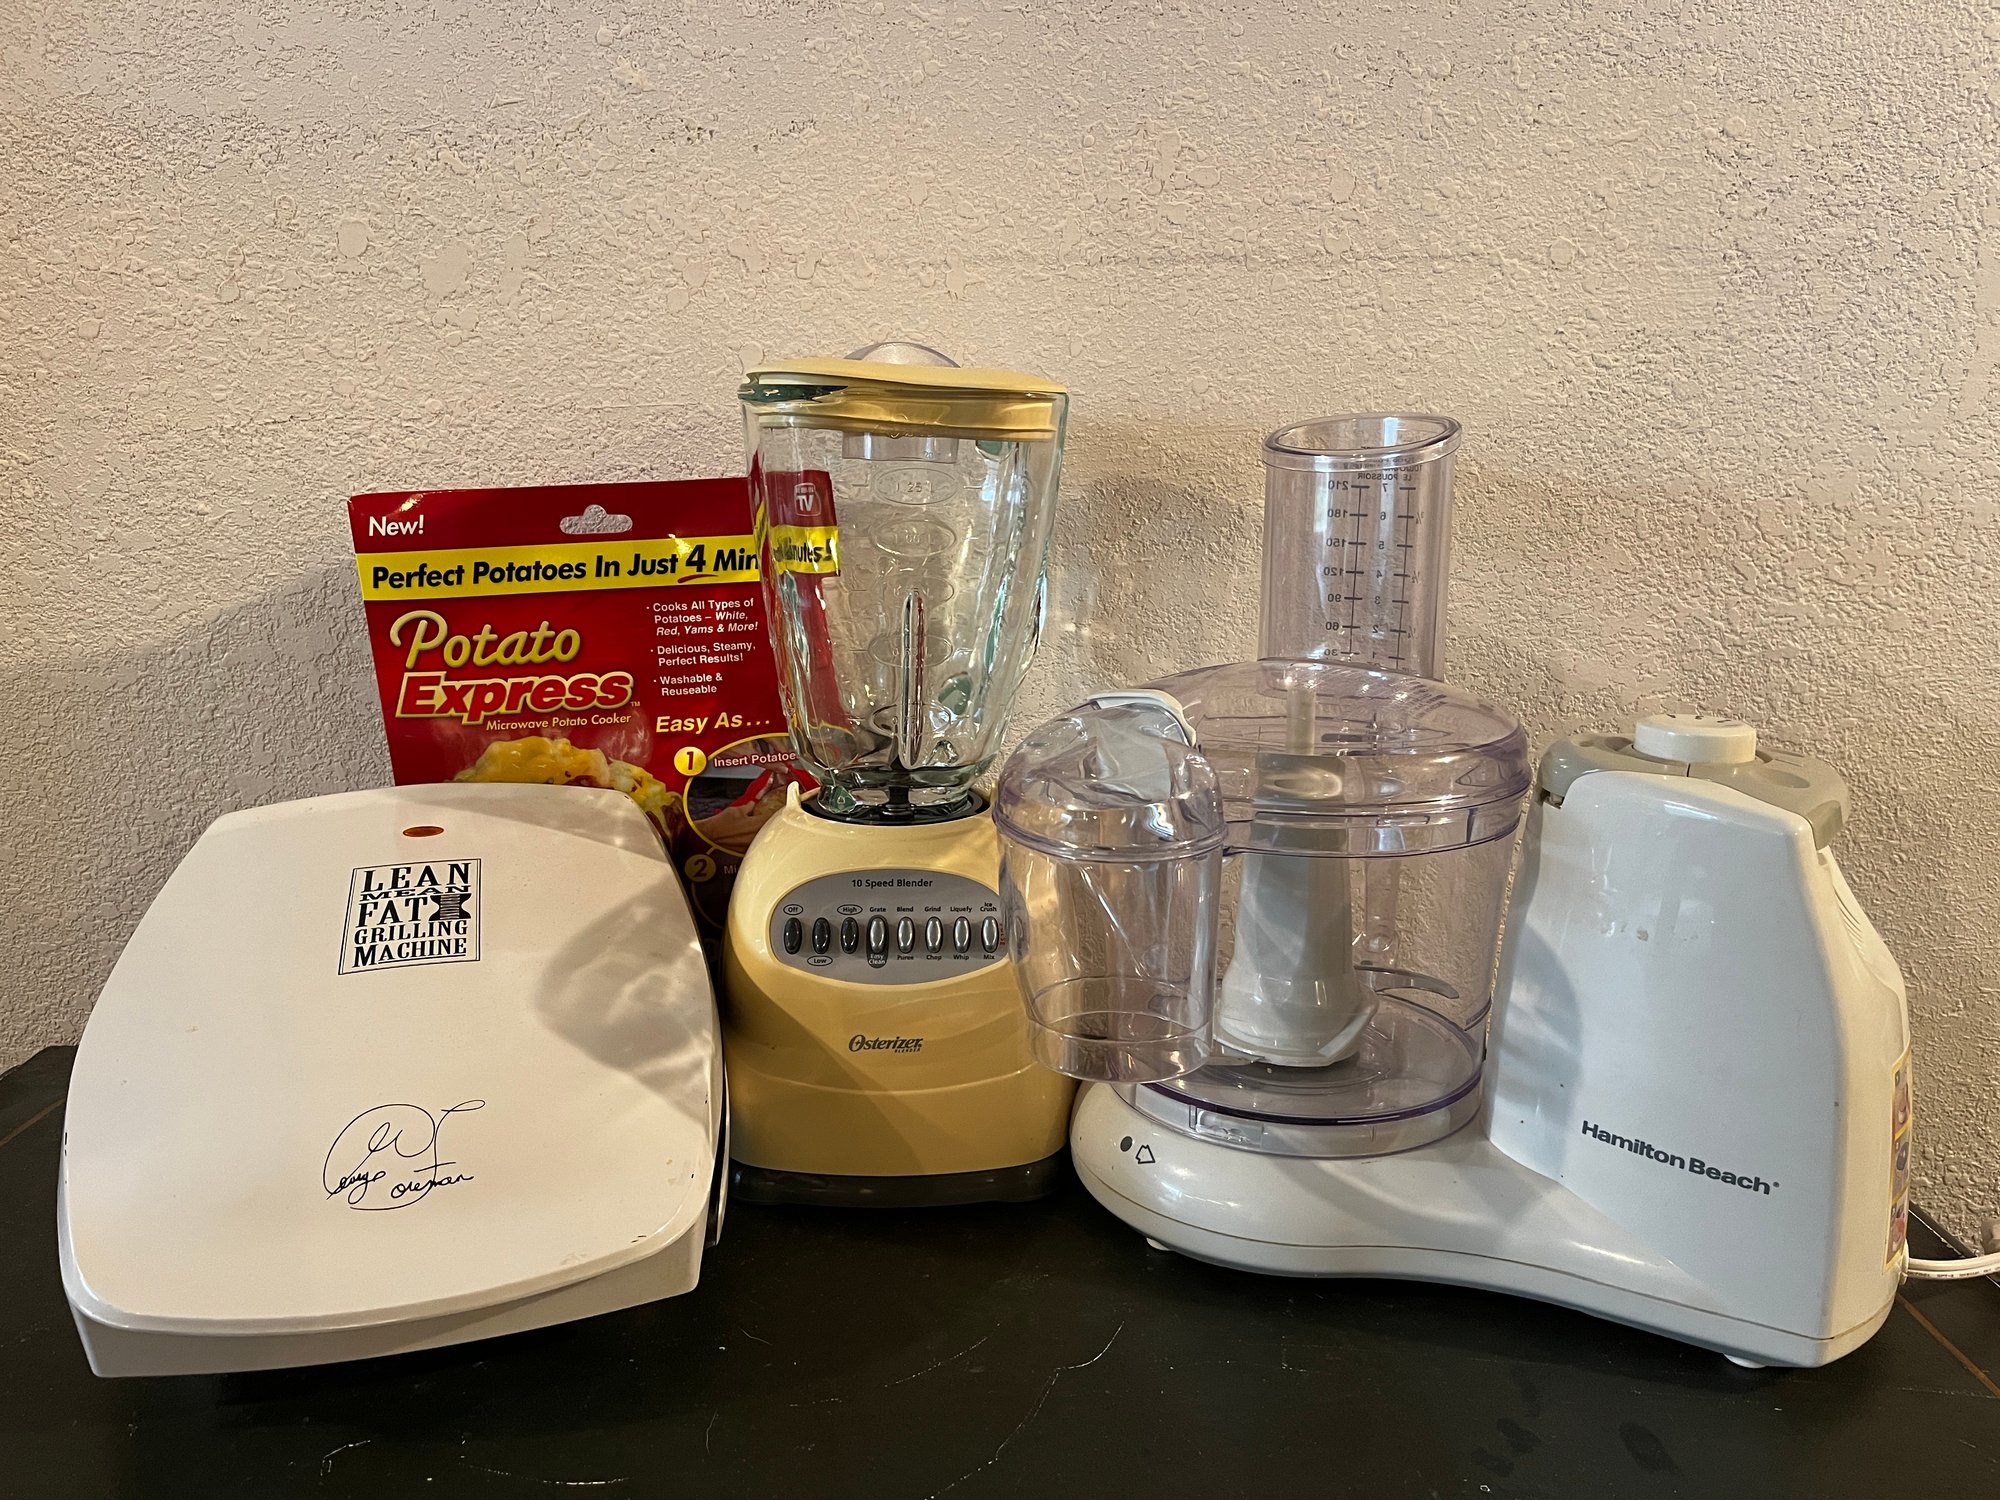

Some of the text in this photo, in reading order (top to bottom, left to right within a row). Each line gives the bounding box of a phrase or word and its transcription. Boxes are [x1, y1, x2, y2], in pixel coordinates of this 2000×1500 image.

[797, 495, 814, 512] TV
[369, 514, 424, 536] New!
[373, 563, 464, 589] Perfect
[473, 560, 587, 585] Potatoes
[595, 556, 620, 577] In
[627, 553, 679, 576] Just
[685, 544, 706, 572] 4
[653, 598, 754, 612] Cooks All Types of
[654, 614, 702, 624] Potatoes
[715, 610, 748, 621] White,
[656, 622, 758, 636] Red, Yams & More!
[390, 610, 581, 669] Potato
[657, 642, 756, 655] Delicious, Steamy,
[658, 653, 743, 667] Perfect Results!
[660, 672, 723, 685] Washable &
[396, 671, 634, 725] Express
[662, 685, 717, 696] Reuseable
[486, 714, 631, 731] Microwave Potato Cooker
[656, 716, 708, 734] Easy
[686, 751, 694, 770] 1
[714, 752, 801, 768] Insert Potatoe
[693, 858, 708, 878] 2
[362, 862, 471, 893] LEAN
[851, 879, 933, 889] 10 Speed Blender
[360, 885, 471, 901] MEAN
[356, 896, 427, 928] FAT
[950, 906, 972, 914] Liquefy
[354, 920, 468, 945] GRILLING
[352, 938, 467, 968] MACHINE
[848, 1034, 923, 1052] Osterizer
[1581, 1120, 1771, 1195] Hamilton Beach
